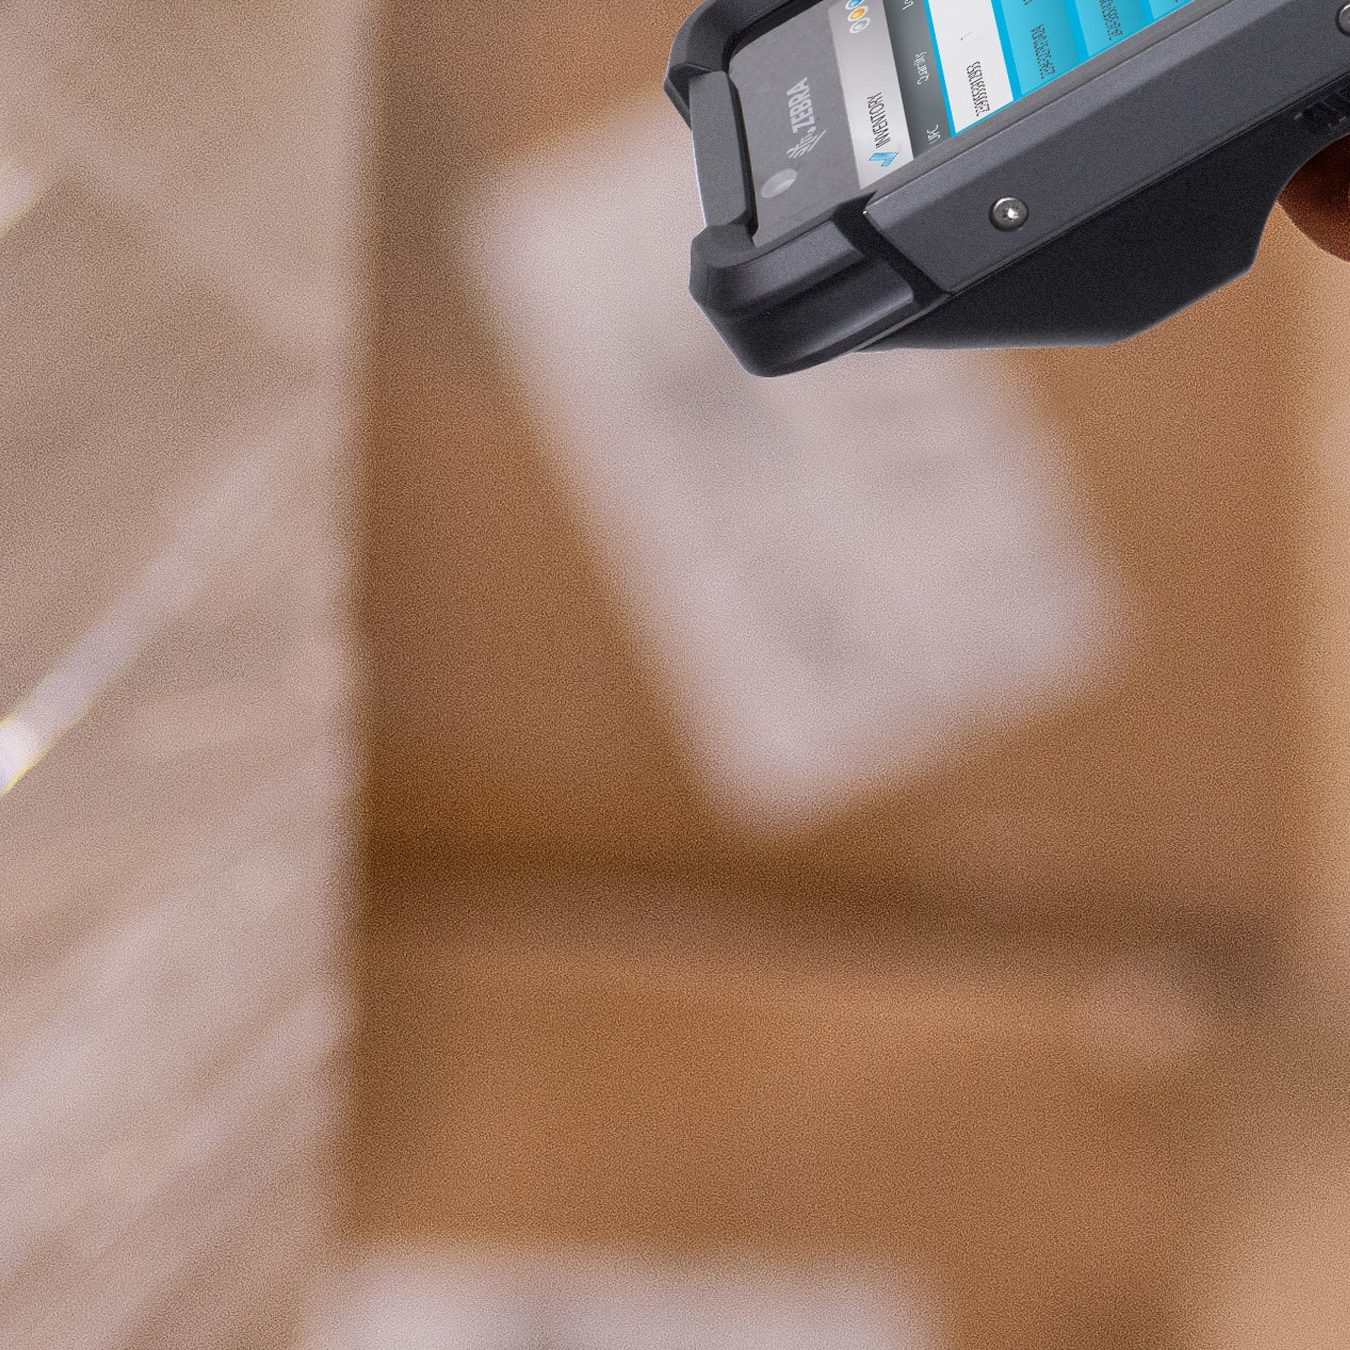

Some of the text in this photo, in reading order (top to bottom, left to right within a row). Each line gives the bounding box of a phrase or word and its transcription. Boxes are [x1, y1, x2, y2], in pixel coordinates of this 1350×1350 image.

[913, 51, 929, 85] Quantity
[786, 77, 815, 133] ZEBRA
[867, 92, 890, 149] INVENTORY
[926, 124, 941, 144] UPC
